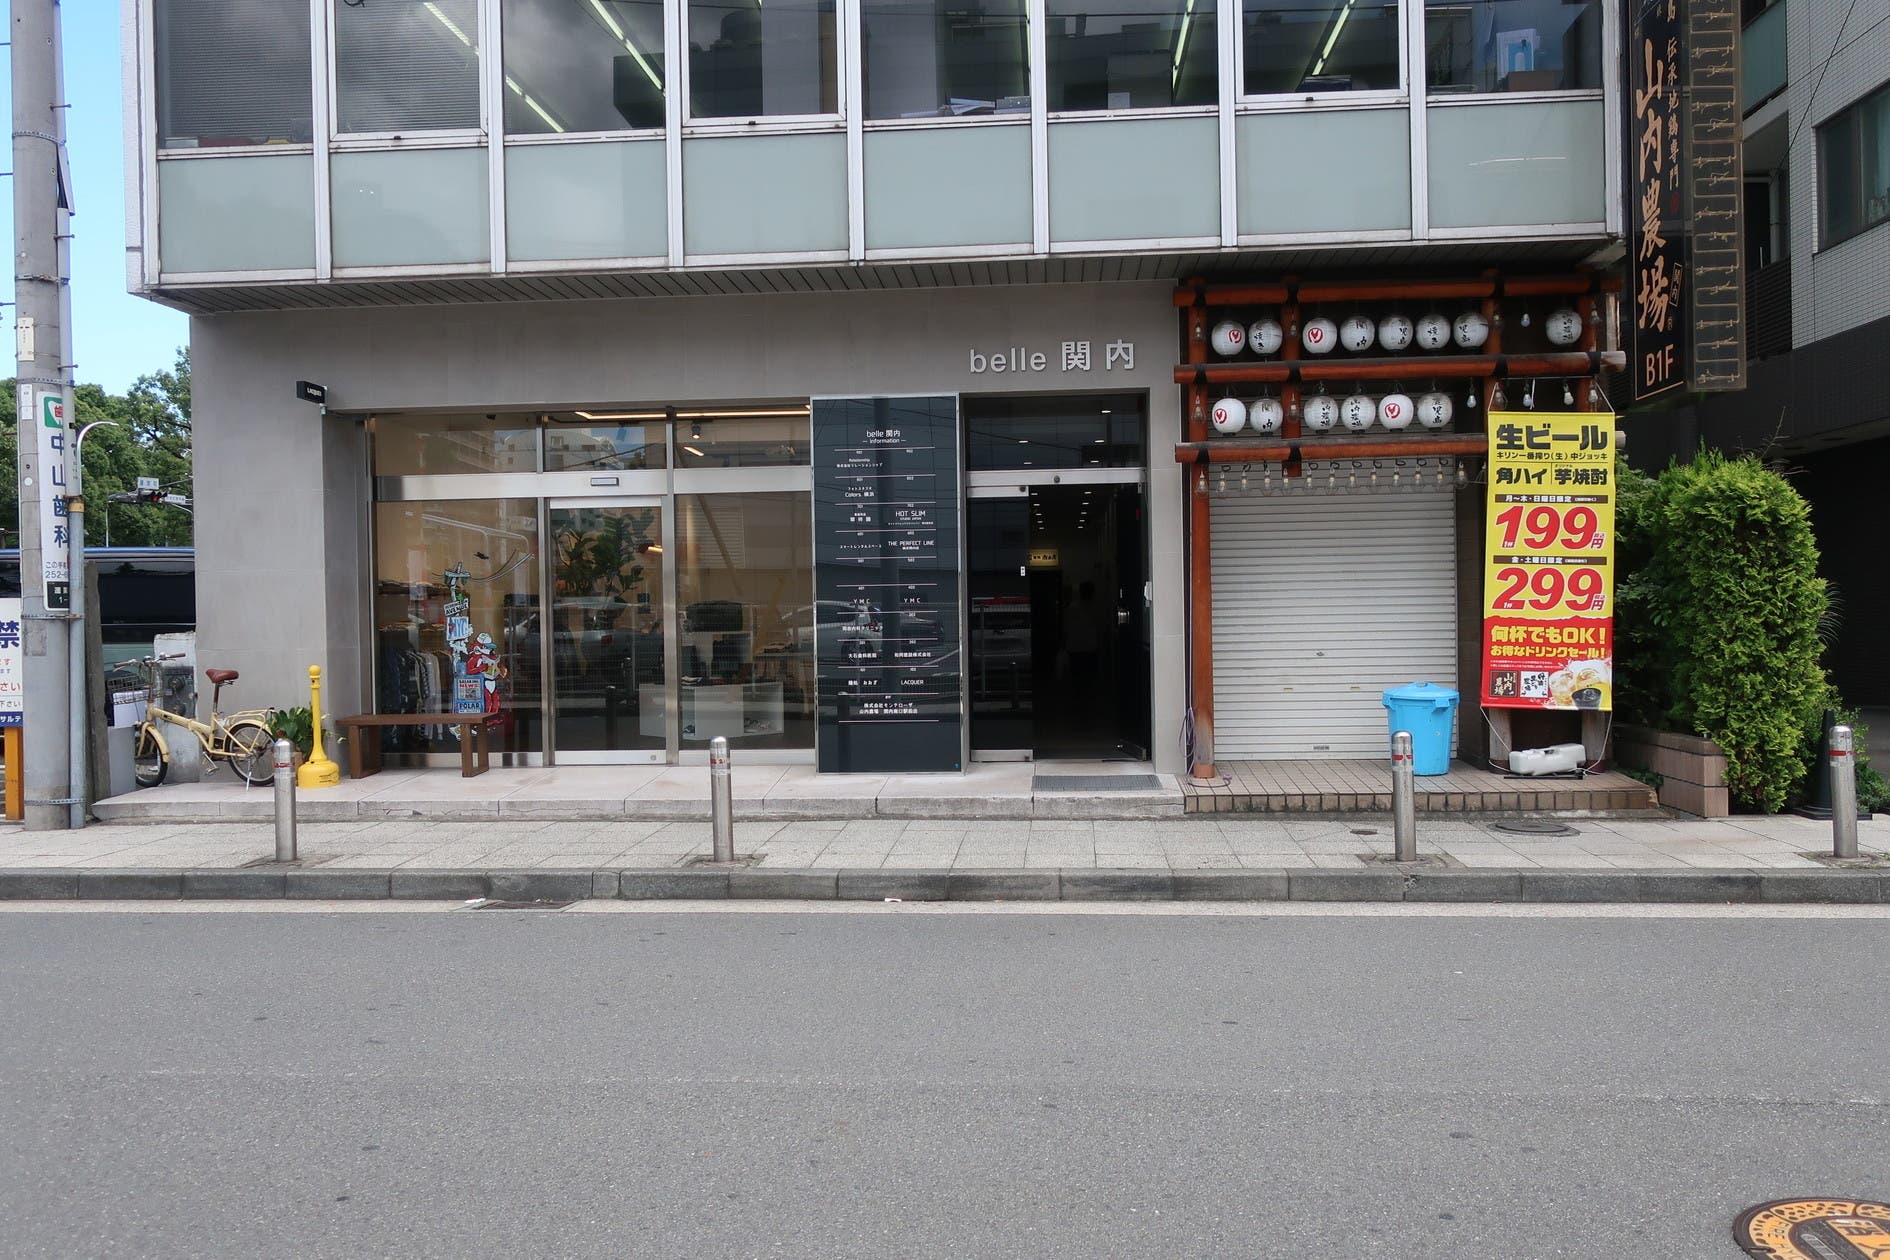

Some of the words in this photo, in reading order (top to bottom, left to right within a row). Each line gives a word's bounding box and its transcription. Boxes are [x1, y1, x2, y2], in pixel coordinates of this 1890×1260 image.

[1636, 38, 1669, 332] 山内農場
[969, 347, 1047, 373] belle
[1061, 338, 1135, 372] 関内
[1645, 344, 1674, 387] B1F
[866, 429, 884, 438] belle
[1496, 423, 1608, 450] 生ビール
[51, 433, 69, 548] 中山歯科
[1496, 467, 1547, 485] 角ハイ
[1554, 468, 1608, 486] 芋焼酎
[1495, 505, 1598, 550] 199
[1491, 567, 1603, 611] 299
[459, 702, 480, 710] POLAR
